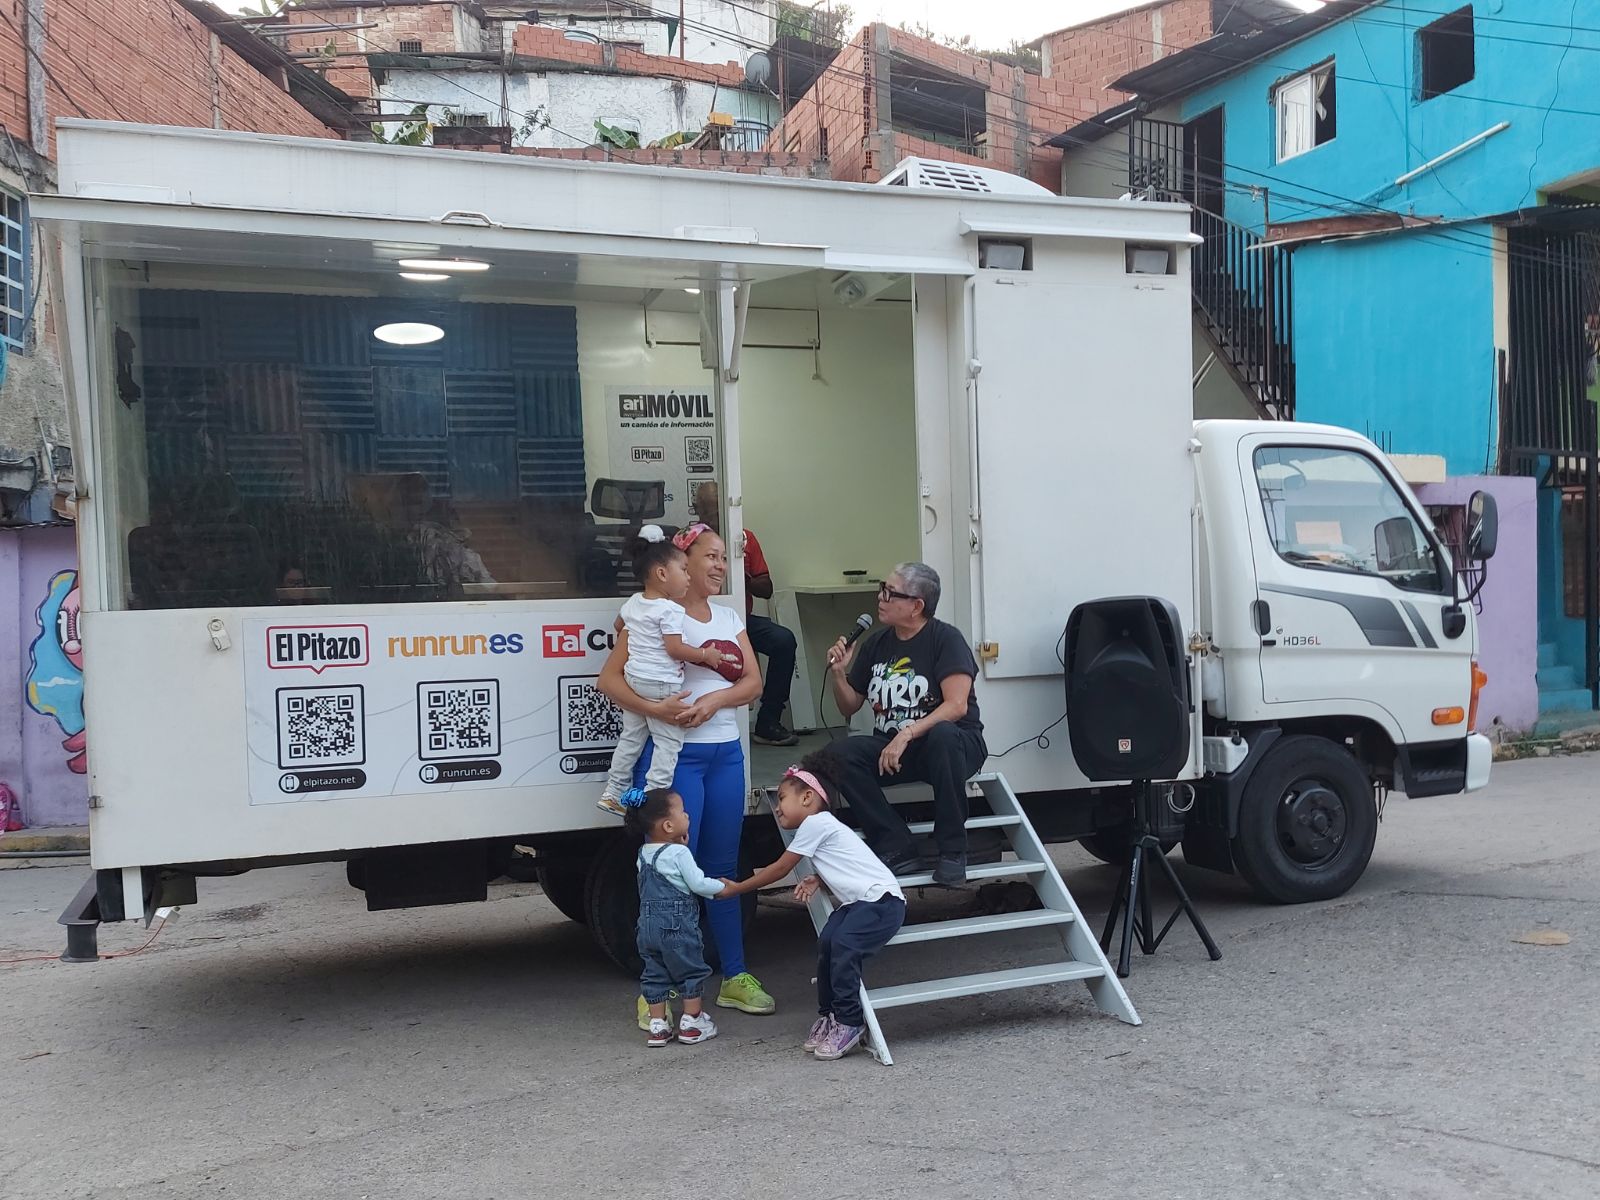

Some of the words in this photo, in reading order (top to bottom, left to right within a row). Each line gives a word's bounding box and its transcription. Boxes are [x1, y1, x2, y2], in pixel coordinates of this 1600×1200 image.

[623, 395, 644, 411] ari
[634, 450, 640, 459] El
[641, 449, 662, 459] Pitazo
[276, 633, 293, 662] El
[298, 632, 361, 661] Pitazo
[1283, 636, 1321, 646] HD36L
[867, 675, 929, 709] BIRD
[442, 766, 491, 779] runrun.es
[303, 775, 356, 789] elpitazo.net
